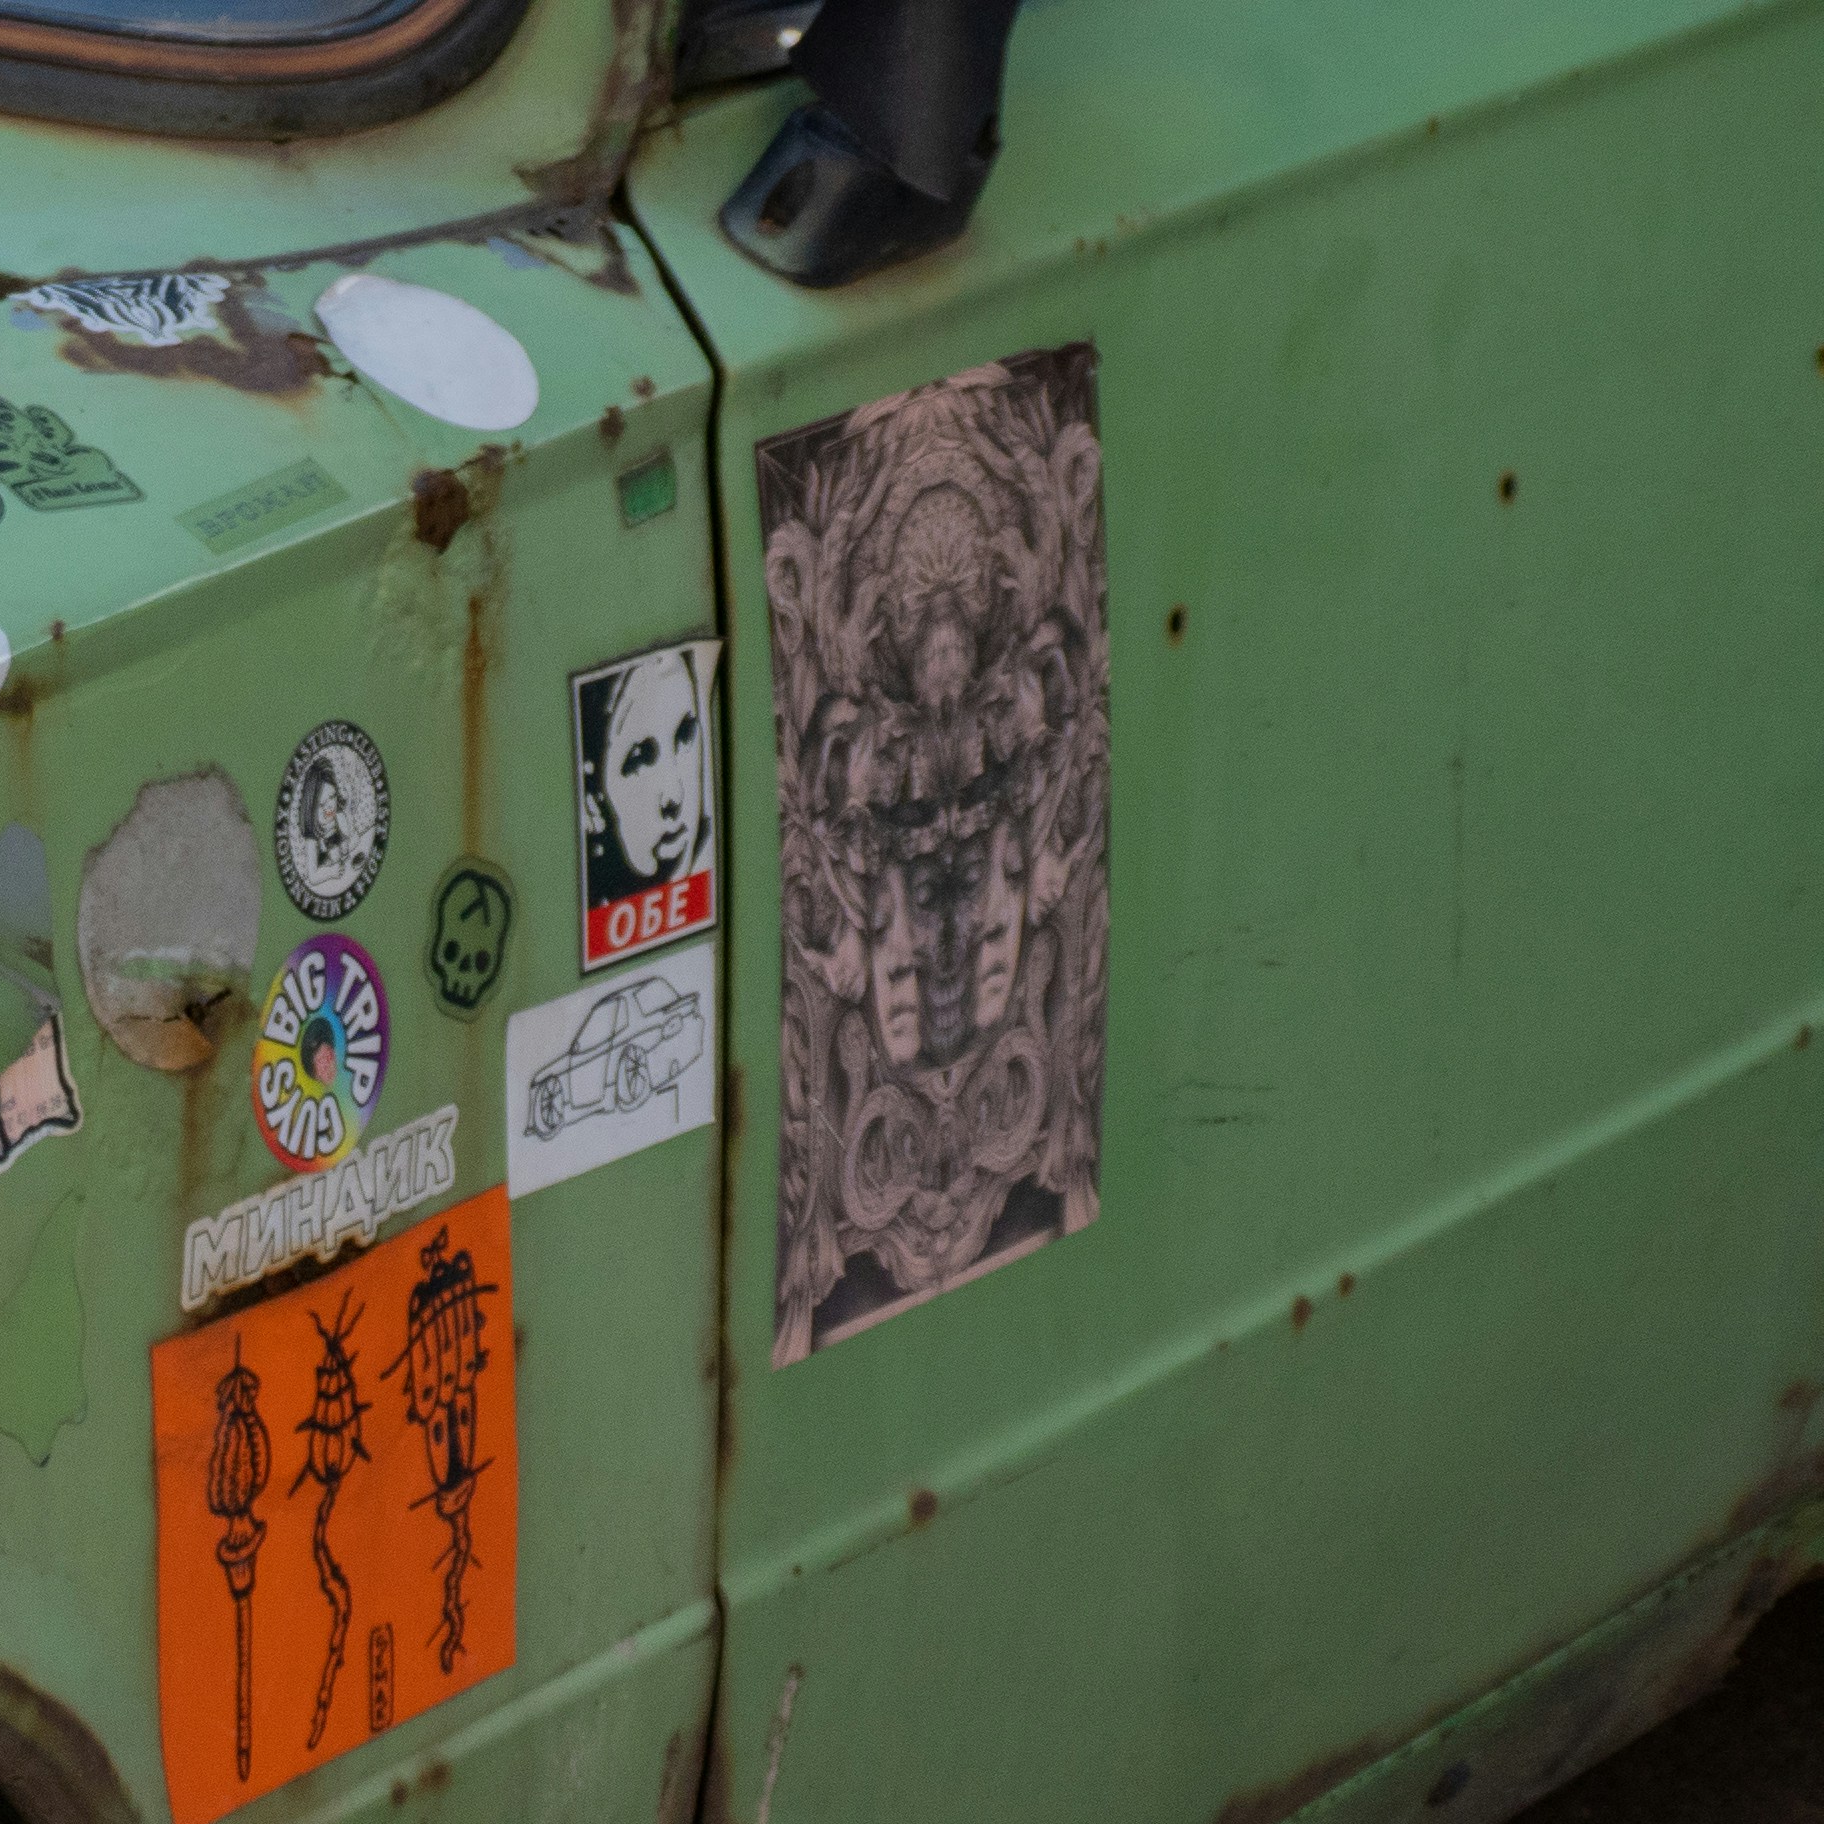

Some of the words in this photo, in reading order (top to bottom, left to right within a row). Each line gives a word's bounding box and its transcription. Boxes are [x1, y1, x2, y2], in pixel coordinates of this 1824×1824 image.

[285, 724, 349, 785] TASTING
[354, 734, 382, 778] CLUB
[276, 808, 341, 918] MELANCHOLY
[264, 951, 325, 1046] BIG
[335, 952, 382, 1107] TRIP
[259, 1058, 344, 1159] GUYS
[188, 1115, 453, 1302] МИНДИК
